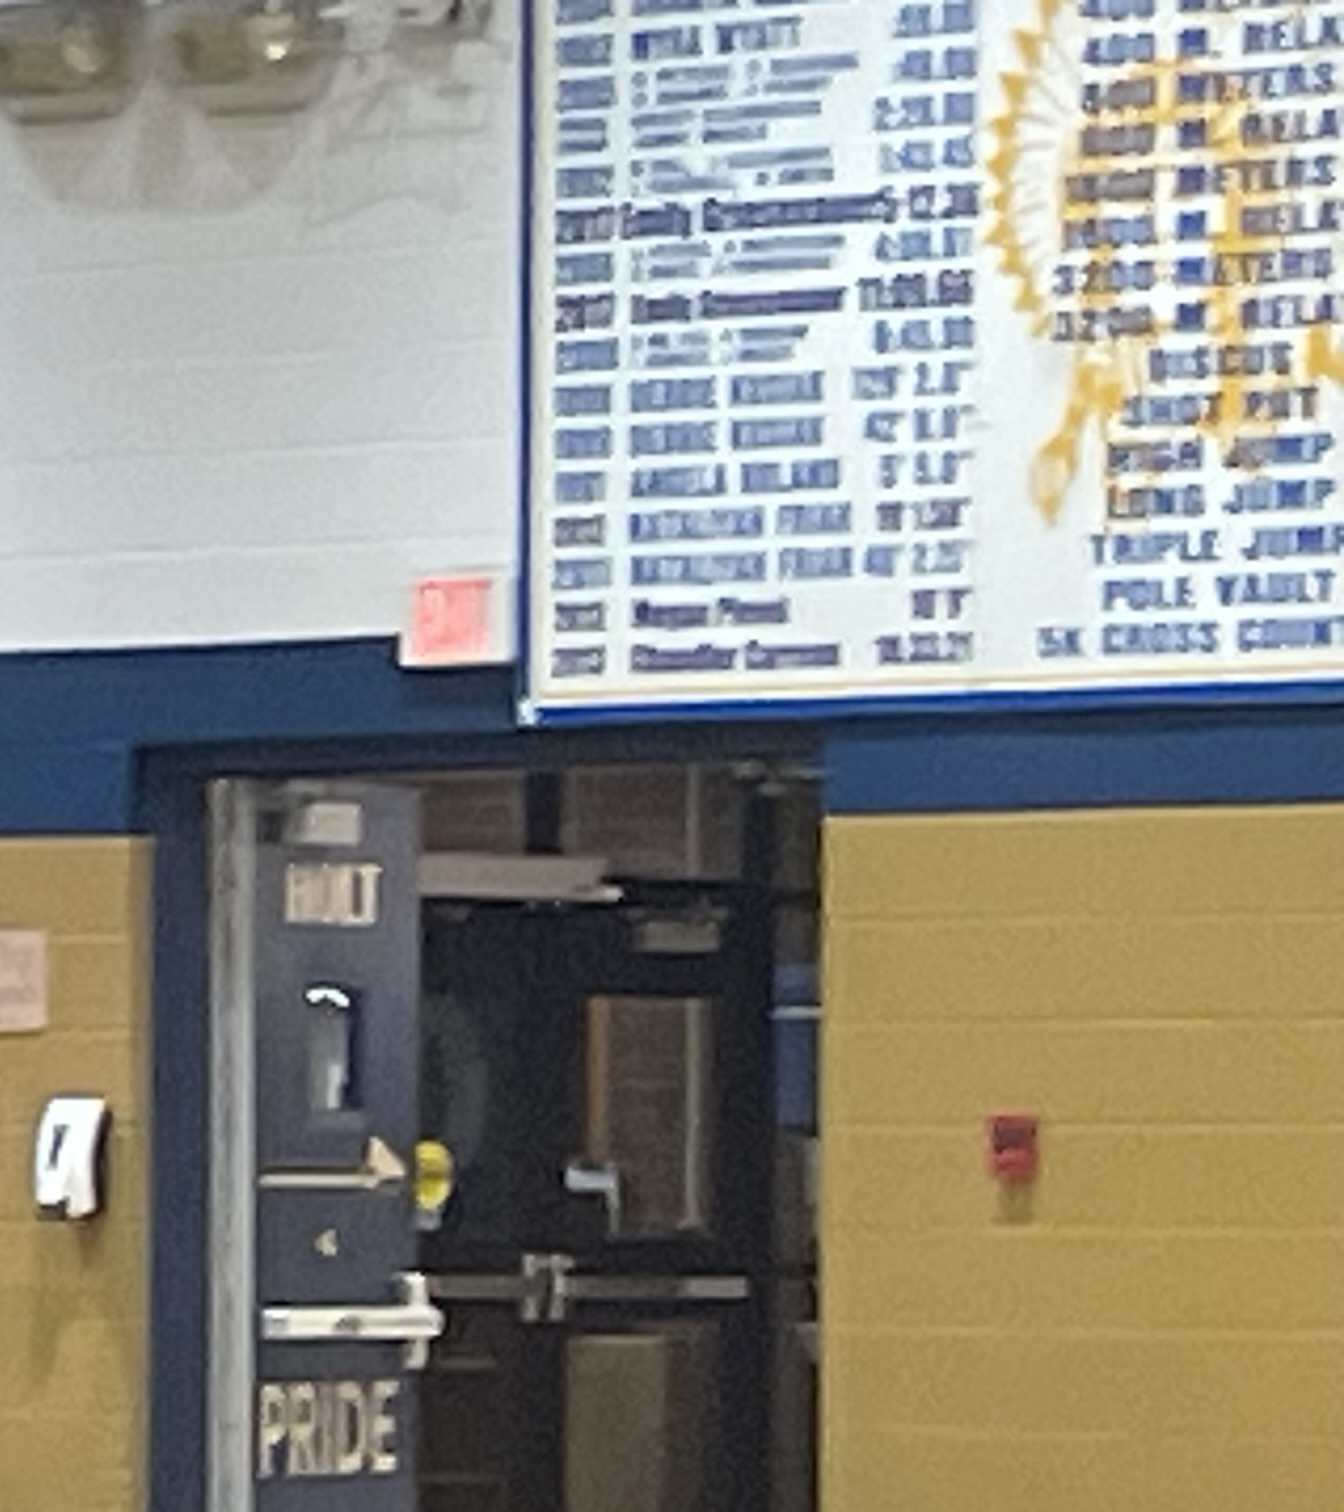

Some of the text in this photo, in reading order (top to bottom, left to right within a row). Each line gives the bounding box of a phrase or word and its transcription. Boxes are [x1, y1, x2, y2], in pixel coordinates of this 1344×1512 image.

[1242, 14, 1344, 54] RELA
[1241, 108, 1344, 146] RELA
[1241, 199, 1344, 236] RELA
[1241, 294, 1344, 330] RELA
[1106, 478, 1334, 519] LONG JUMP
[1089, 529, 1222, 565] TRIPLE
[1101, 568, 1337, 611] POLE VAULT
[1100, 621, 1219, 656] CROSS
[256, 1380, 400, 1479] PRIDE
